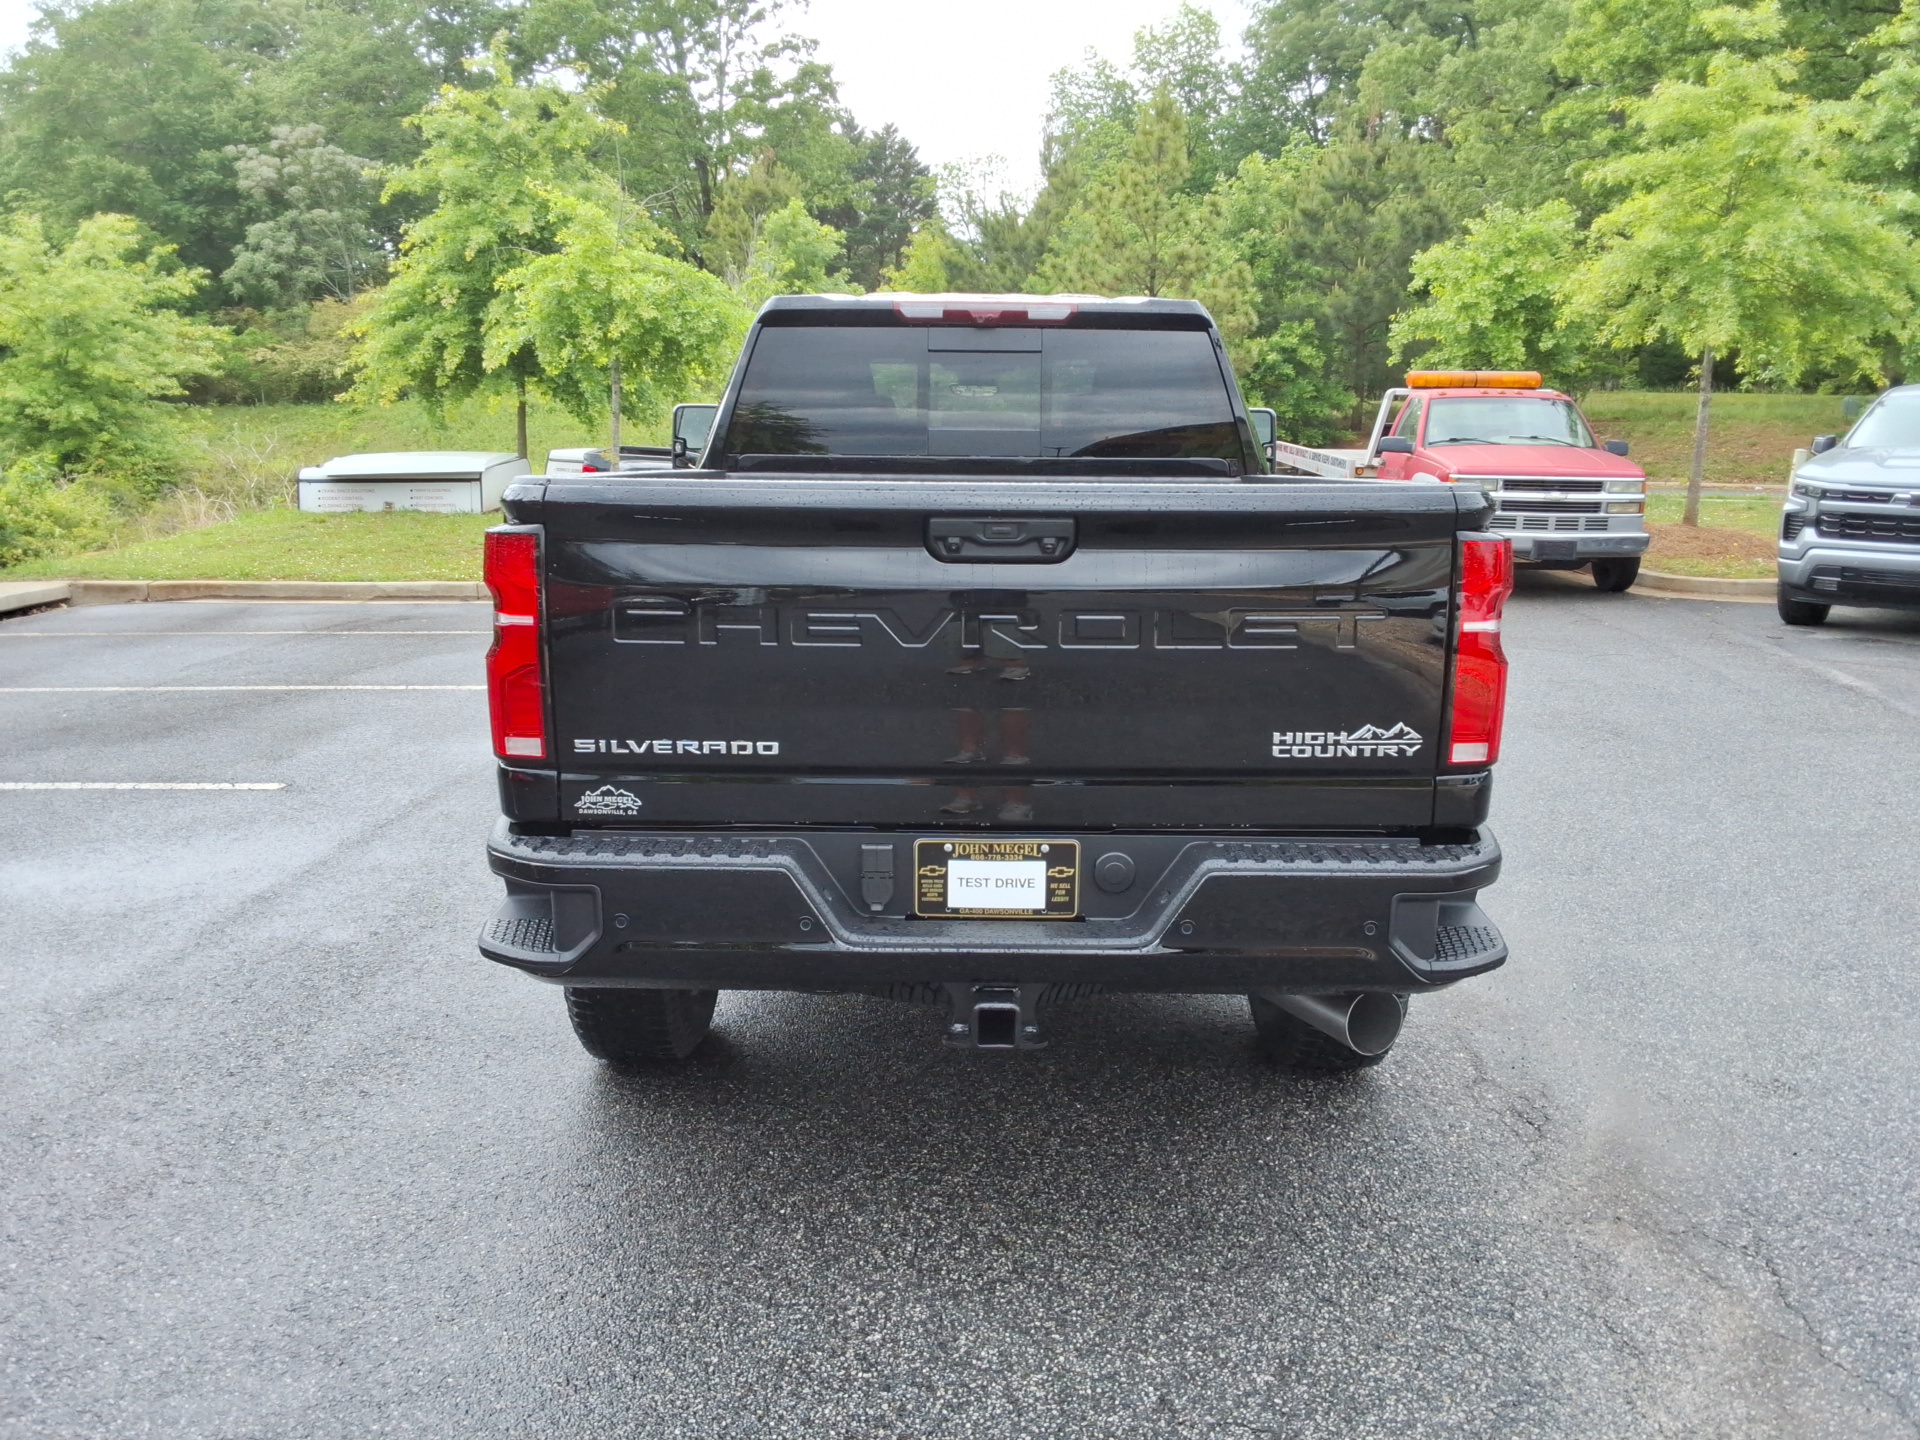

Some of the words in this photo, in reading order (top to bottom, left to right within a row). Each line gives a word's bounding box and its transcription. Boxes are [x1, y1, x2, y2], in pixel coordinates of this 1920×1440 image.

[612, 599, 1388, 649] CHEVROLET
[1273, 732, 1348, 744] HIGH
[574, 739, 779, 755] SILVERADO
[1272, 745, 1422, 757] COUNTRY
[581, 796, 603, 805] JOHN
[604, 796, 633, 804] MEGEL
[952, 843, 989, 858] JOHN
[992, 843, 1041, 857] MEGEL
[957, 877, 990, 888] TEST
[995, 877, 1036, 888] DRIVE
